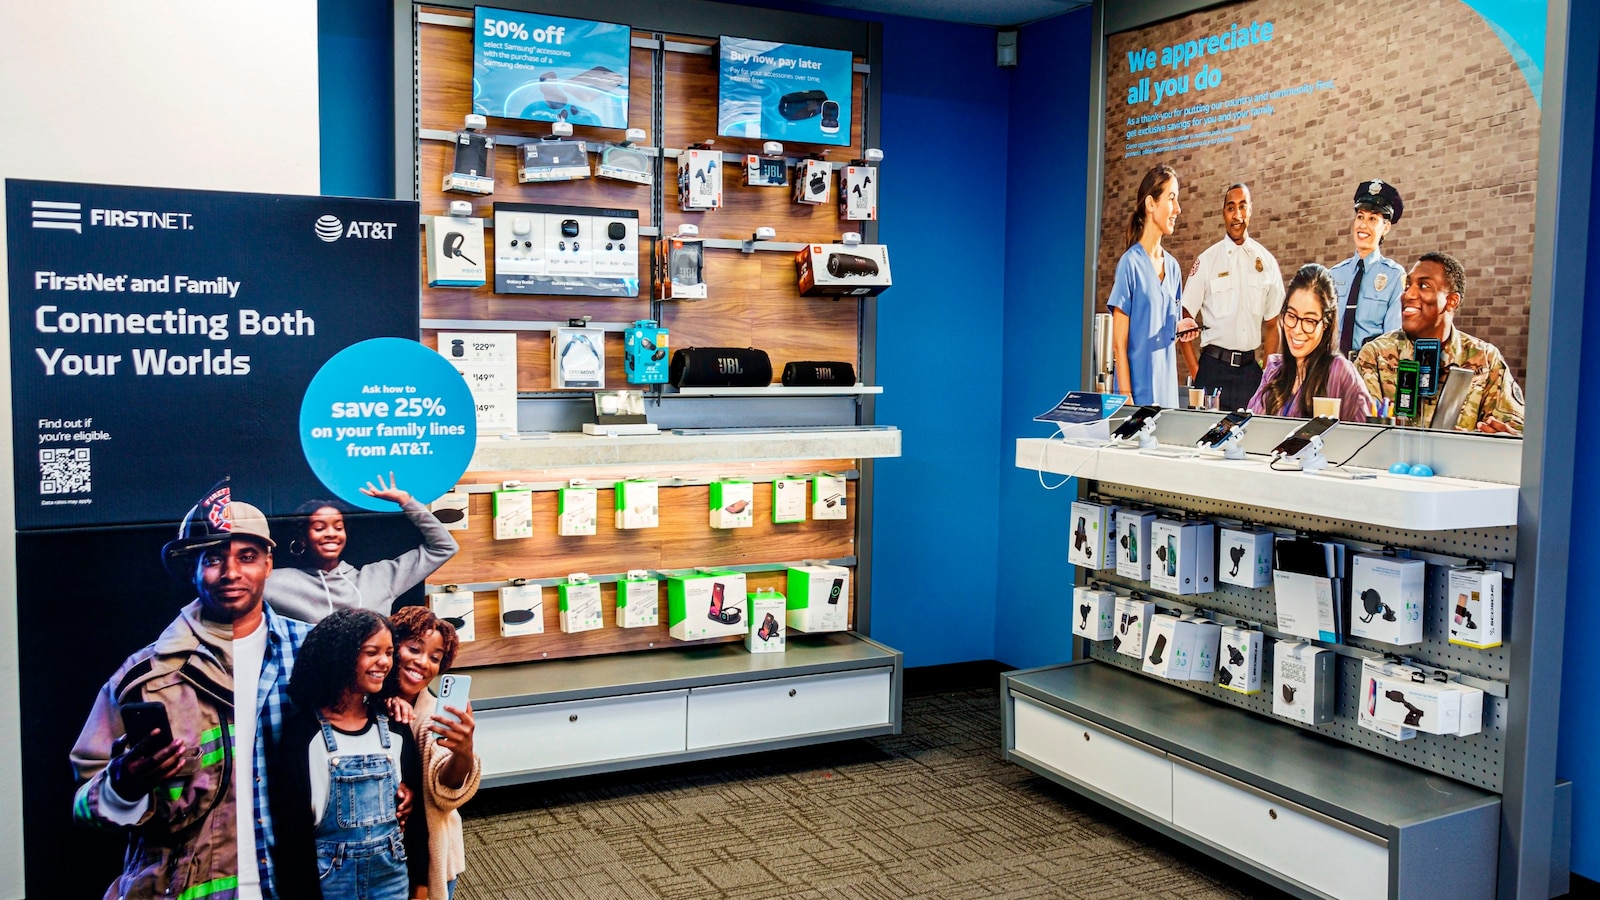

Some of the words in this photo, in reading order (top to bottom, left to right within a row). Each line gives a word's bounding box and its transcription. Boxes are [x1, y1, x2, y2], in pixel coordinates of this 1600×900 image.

[483, 18, 529, 41] 50%
[532, 25, 566, 45] off
[483, 41, 503, 49] select
[536, 48, 571, 57] accessories
[1127, 47, 1157, 73] We
[1160, 20, 1274, 70] appreciate
[483, 50, 498, 58] with
[499, 51, 510, 59] the
[511, 53, 539, 63] purchase
[483, 58, 513, 70] Samsung
[514, 62, 535, 71] device
[730, 51, 751, 64] Buy
[753, 55, 776, 67] now,
[778, 58, 797, 69] pay
[798, 58, 822, 70] later
[729, 66, 740, 75] Pay
[741, 68, 749, 76] for
[749, 70, 762, 78] your
[763, 70, 793, 80] accessories
[1127, 77, 1150, 105] all
[1152, 74, 1189, 107] you
[1194, 63, 1222, 90] do
[1127, 118, 1135, 126] As
[1141, 112, 1173, 124] thank-you
[1173, 108, 1183, 117] for
[1184, 103, 1210, 117] putting
[1211, 101, 1223, 110] our
[1224, 95, 1252, 108] country
[1253, 90, 1268, 103] and
[1269, 83, 1314, 100] community
[1126, 130, 1137, 140] get
[1138, 124, 1166, 136] exclusive
[1167, 120, 1191, 131] savings
[1192, 116, 1202, 126] for
[1203, 115, 1216, 126] you
[1217, 111, 1231, 122] and
[1232, 110, 1249, 122] your
[764, 164, 783, 178] JBL
[346, 220, 398, 240] AT&T
[680, 267, 697, 279] JBL
[130, 274, 170, 294] and
[174, 275, 241, 299] Family
[35, 304, 229, 341] Connecting
[238, 309, 316, 336] Both
[35, 347, 122, 376] Your
[132, 347, 251, 376] Worlds
[717, 357, 743, 375] JBL
[815, 367, 835, 381] JBL
[362, 385, 381, 394] Ask
[383, 384, 403, 394] how
[405, 385, 416, 394] to
[331, 401, 389, 419] save
[394, 397, 446, 418] 25%
[38, 418, 62, 429] Find
[63, 419, 83, 428] out
[84, 417, 93, 428] if
[311, 427, 333, 438] on
[335, 426, 373, 441] your
[376, 422, 426, 439] family
[430, 422, 465, 436] lines
[39, 432, 71, 444] you're
[73, 430, 112, 443] eligible.
[346, 442, 386, 457] from
[389, 442, 433, 456] AT&T.
